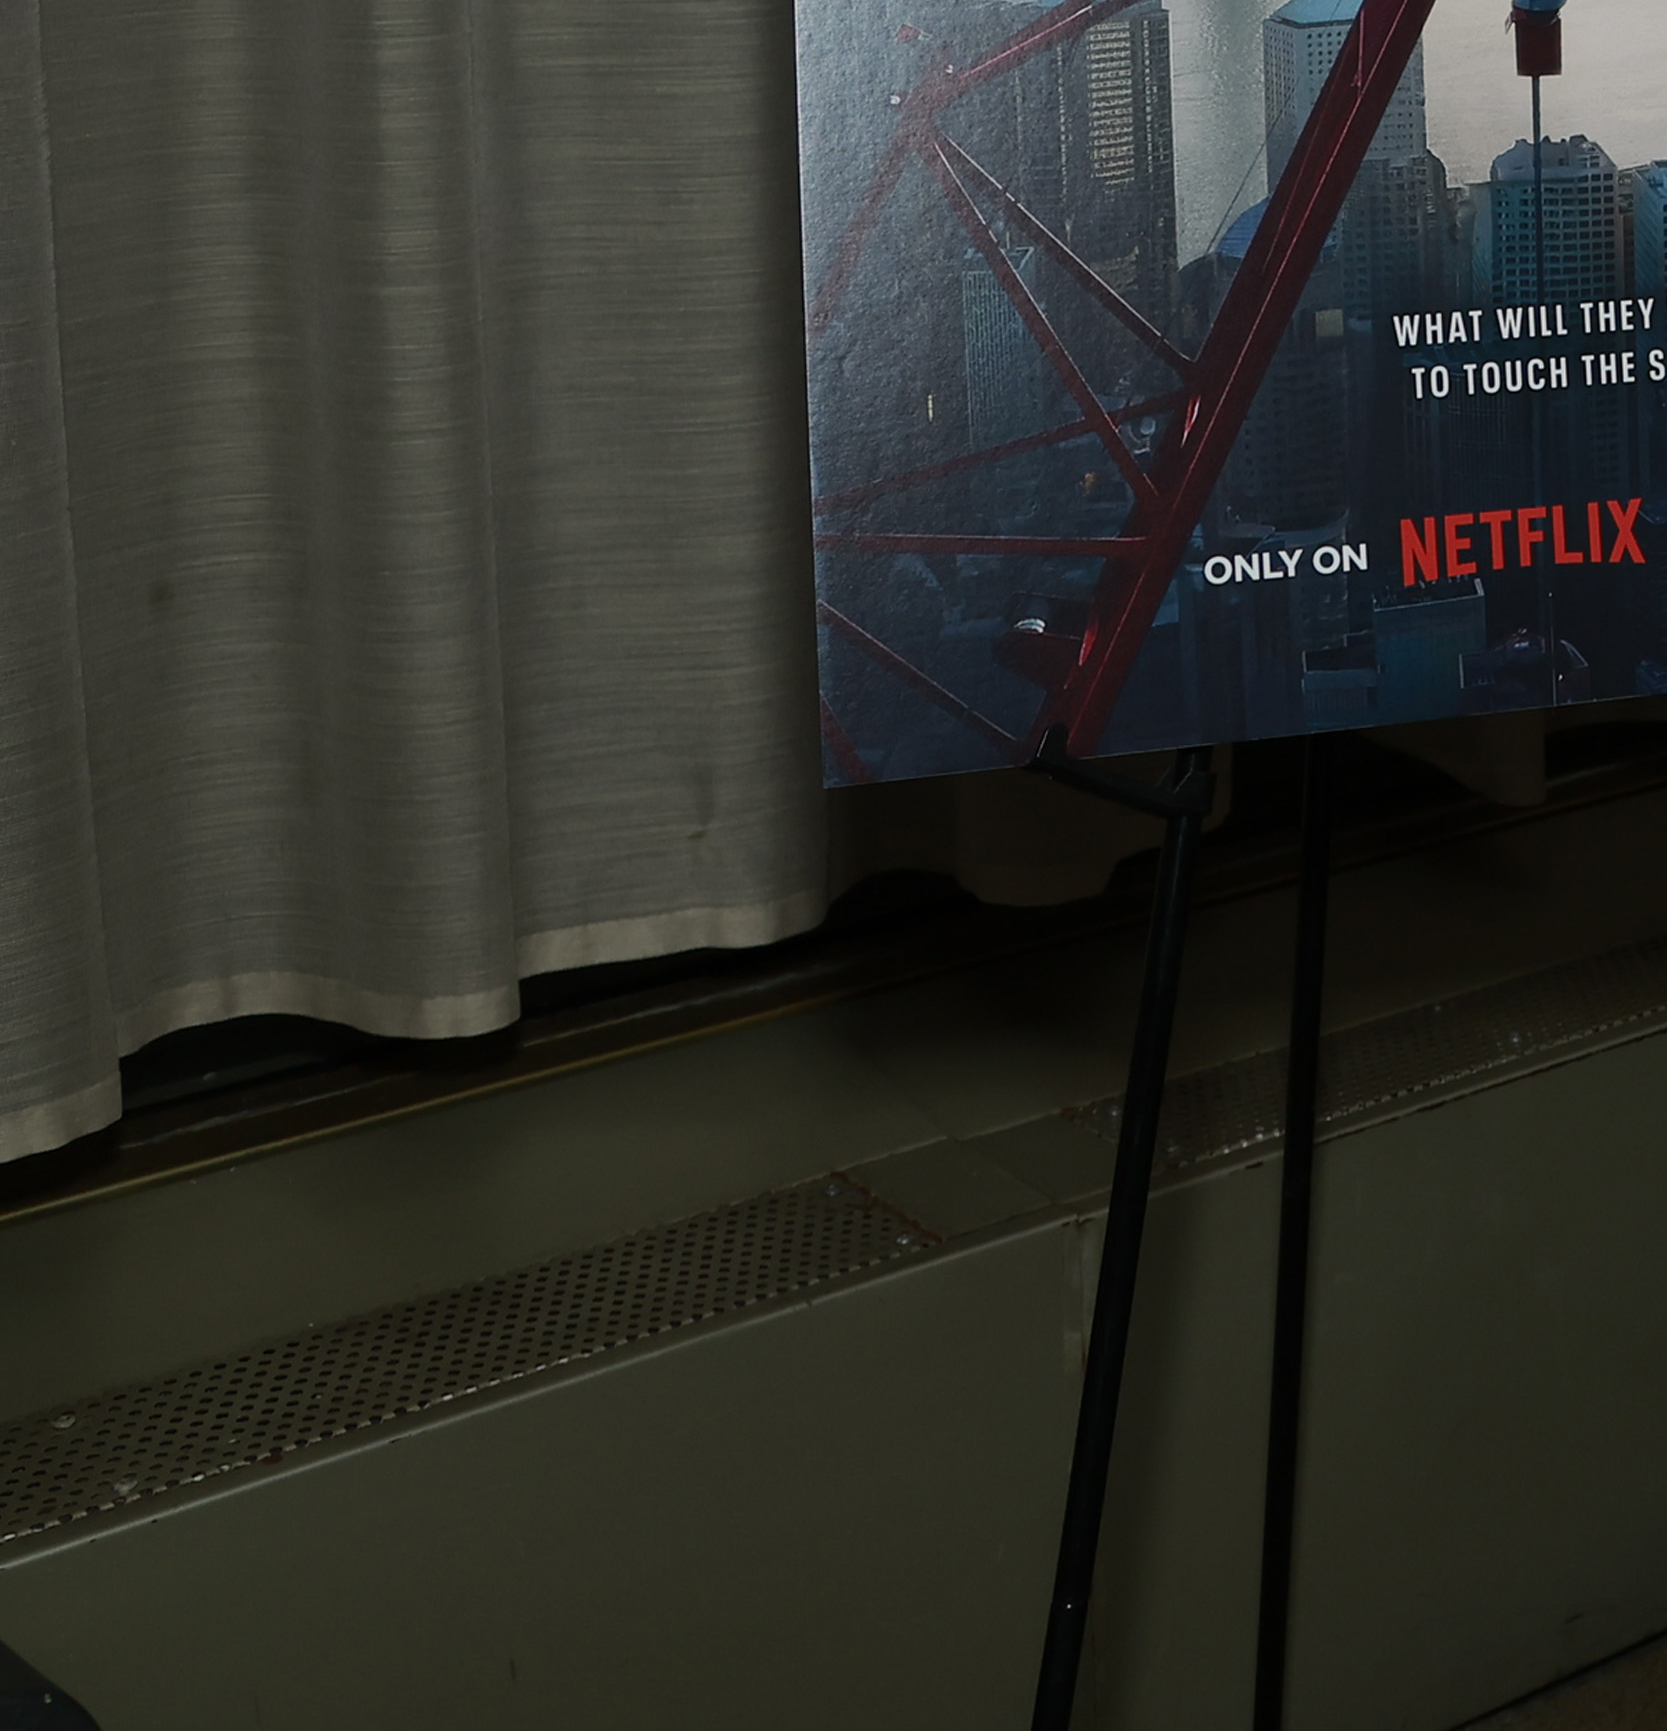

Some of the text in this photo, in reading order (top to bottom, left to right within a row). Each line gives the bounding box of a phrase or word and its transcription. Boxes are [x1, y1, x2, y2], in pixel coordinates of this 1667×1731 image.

[1393, 310, 1483, 347] WHAT
[1496, 304, 1568, 339] WILL
[1579, 298, 1654, 334] THEY
[1411, 365, 1449, 399] TO
[1463, 356, 1568, 395] TOUCH
[1581, 351, 1635, 386] THE
[1204, 548, 1303, 585] ONLY
[1312, 543, 1368, 576] ON
[1400, 497, 1646, 587] NETFLIX
